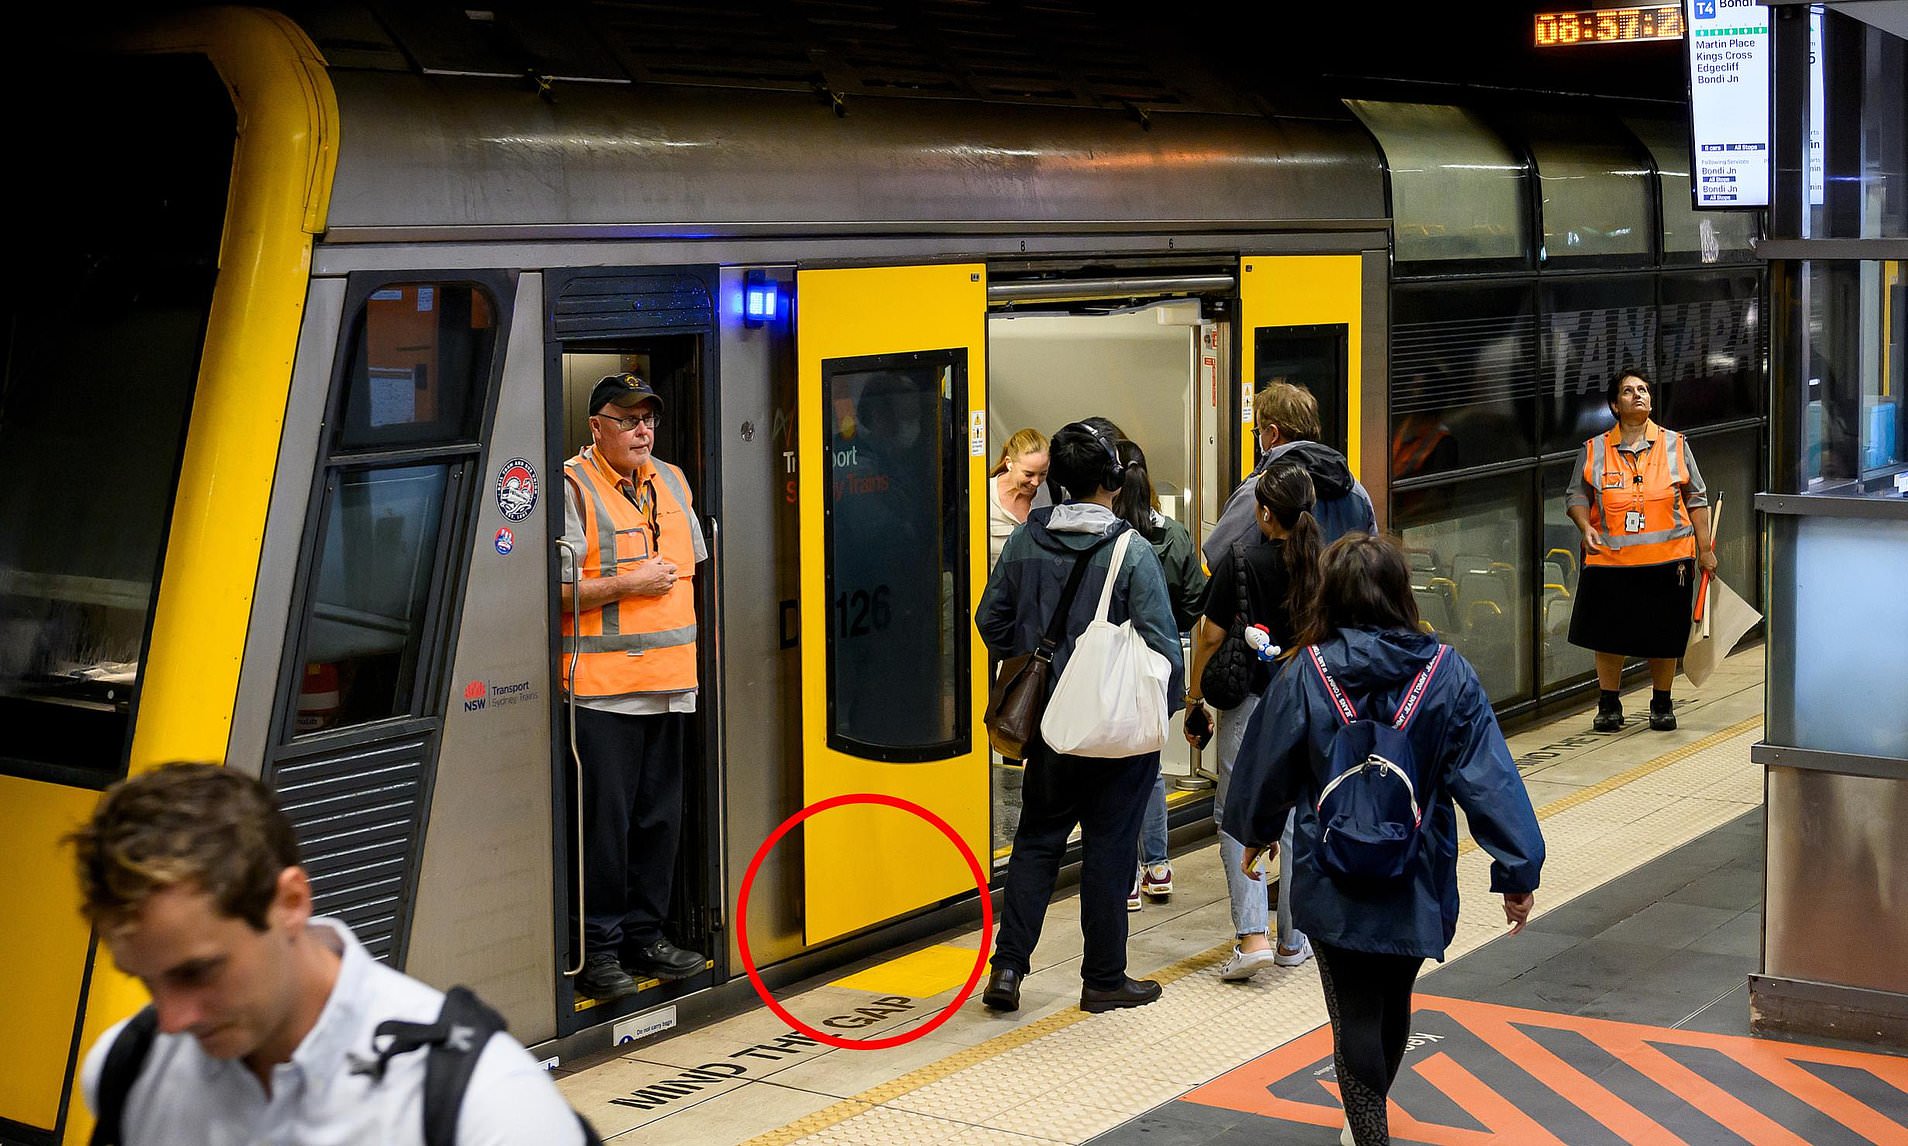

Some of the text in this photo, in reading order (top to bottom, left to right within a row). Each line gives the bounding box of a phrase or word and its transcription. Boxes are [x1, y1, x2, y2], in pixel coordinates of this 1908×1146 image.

[1696, 2, 1714, 15] T4
[1536, 8, 1684, 44] 08:57:2
[1696, 39, 1755, 49] Martin Place
[1696, 51, 1753, 62] Kings Cross
[1697, 62, 1739, 74] Edgecliff
[1697, 75, 1739, 84] Bondi Jn
[1702, 166, 1737, 175] Bondi Jn
[1703, 185, 1738, 193] Bondi Jn
[1020, 238, 1174, 252] 8 6
[491, 681, 530, 696] Transport
[1413, 671, 1428, 694] TOMMY
[463, 698, 487, 713] NSW
[607, 1062, 748, 1111] MIND
[822, 995, 917, 1029] GAP
